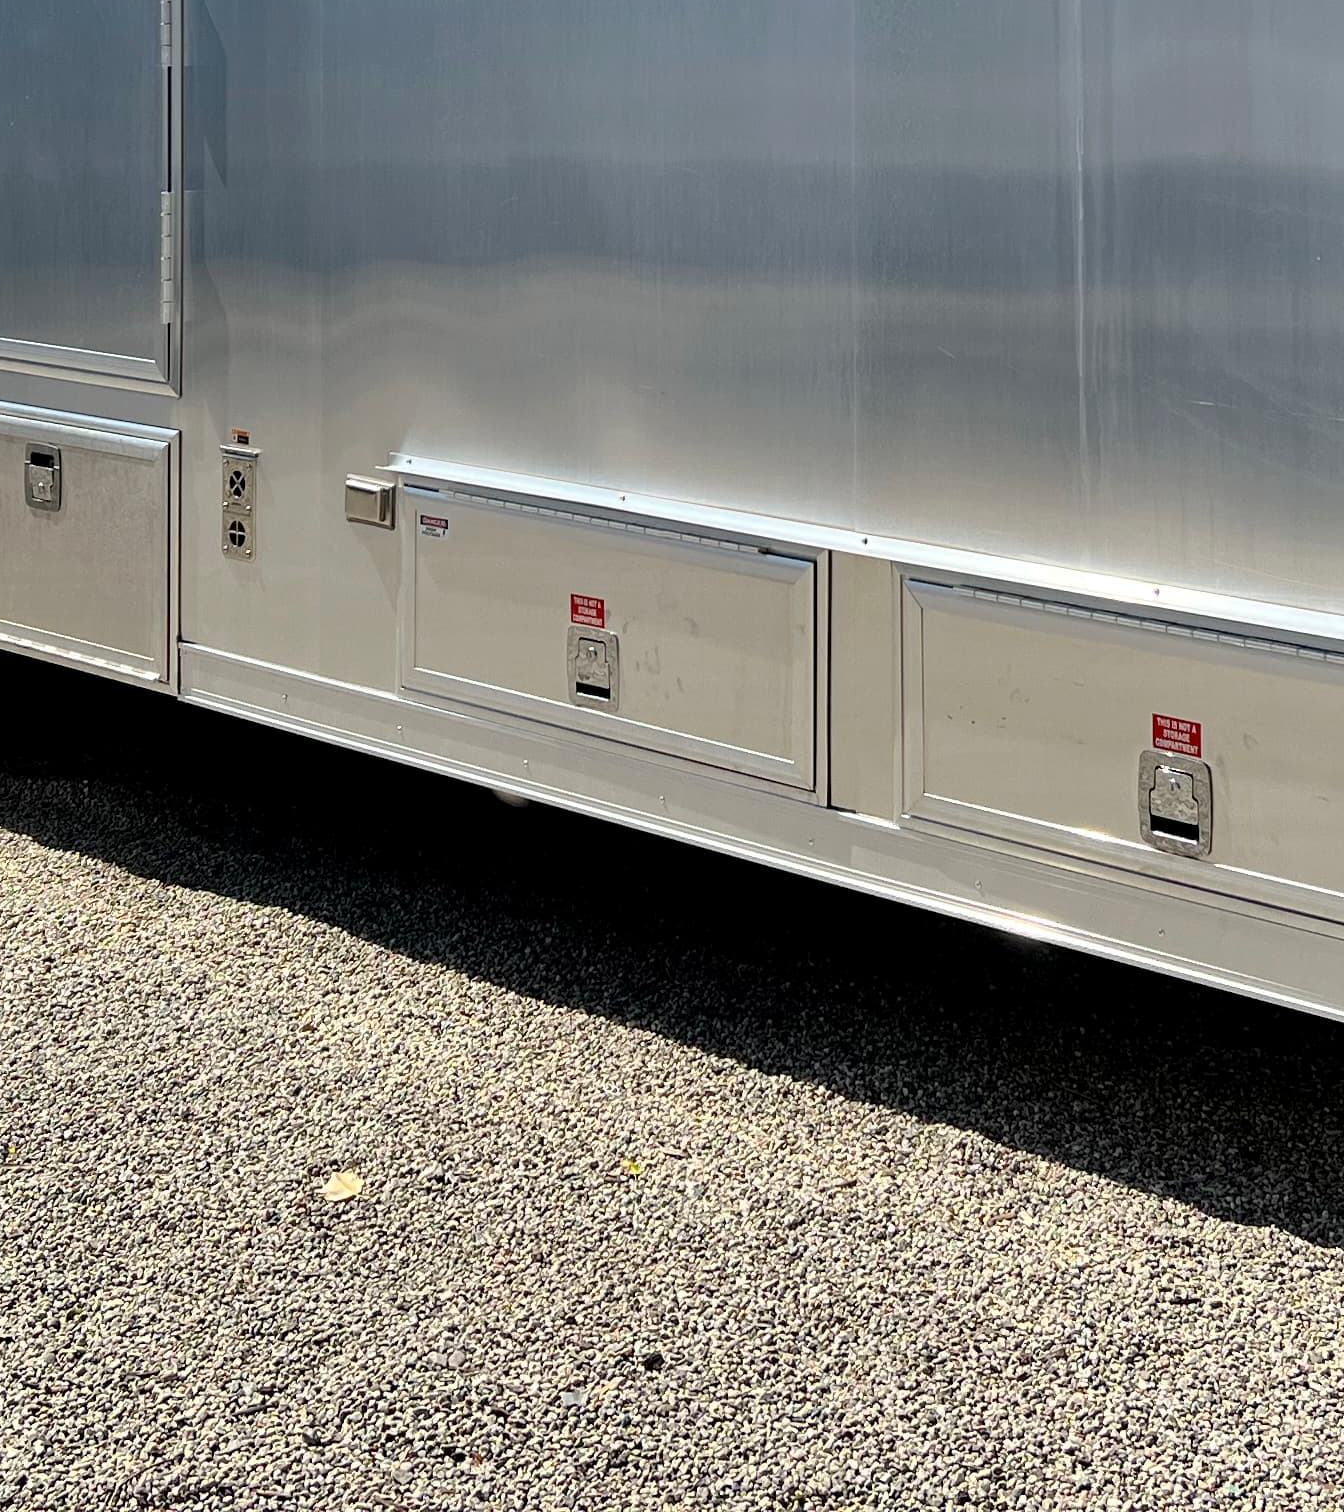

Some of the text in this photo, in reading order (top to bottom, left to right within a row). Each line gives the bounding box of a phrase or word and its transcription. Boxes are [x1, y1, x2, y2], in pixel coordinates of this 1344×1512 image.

[1156, 717, 1170, 729] THIS
[1178, 721, 1190, 733] NOT
[1163, 728, 1191, 743] STORAGE
